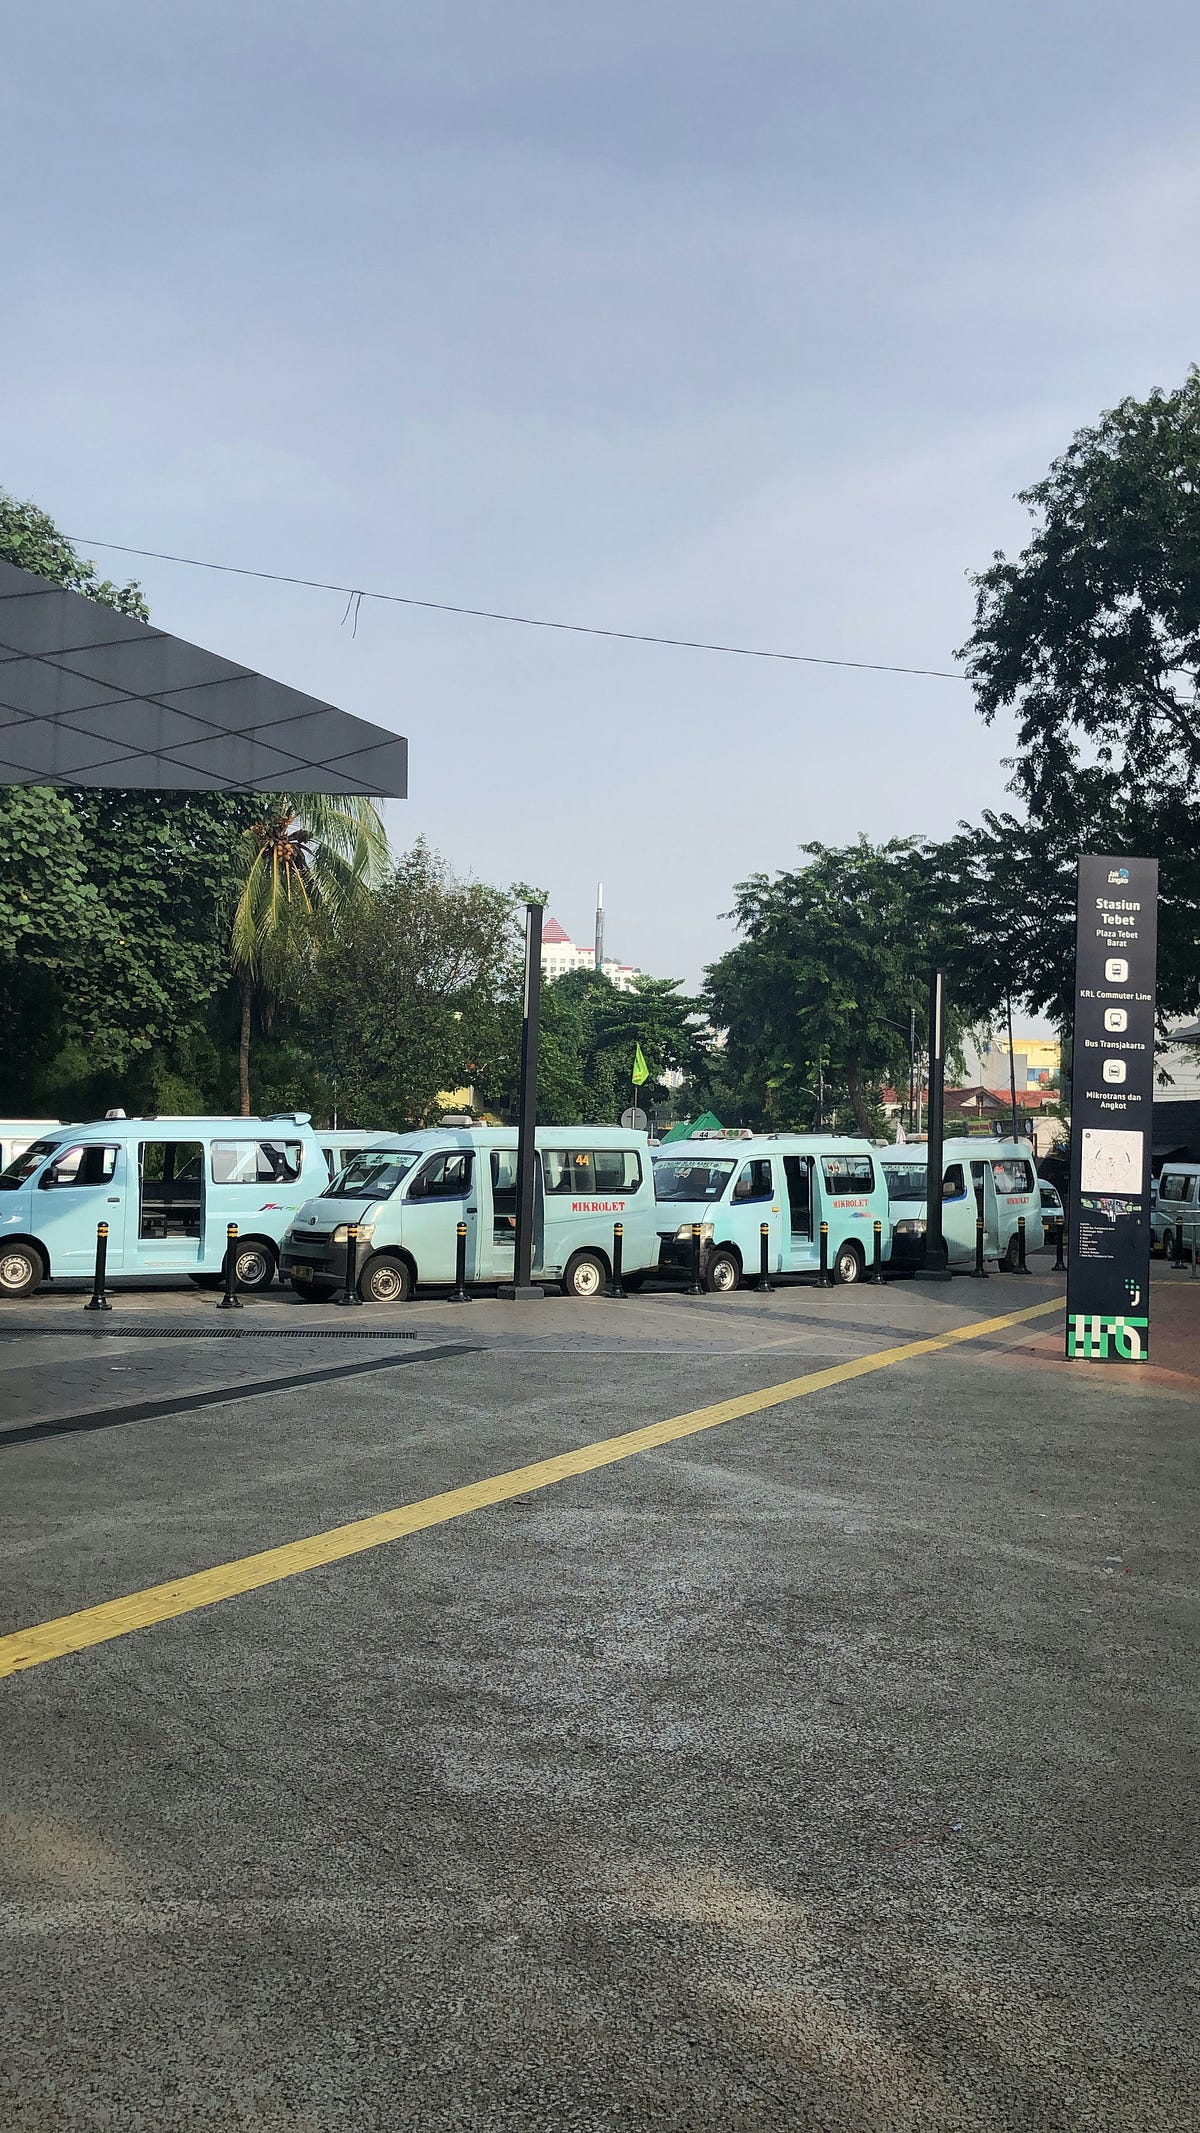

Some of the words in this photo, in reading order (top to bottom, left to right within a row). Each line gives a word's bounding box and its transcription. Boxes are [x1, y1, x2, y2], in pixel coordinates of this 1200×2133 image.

[1095, 898, 1141, 911] Stasiun
[1101, 913, 1135, 926] Tebet
[1096, 929, 1117, 938] Plaza
[1117, 930, 1138, 939] Tebet
[1107, 938, 1127, 947] Barat
[1080, 990, 1095, 998] KRL
[1096, 990, 1134, 1000] Commuter
[1135, 992, 1152, 1001] Line
[1085, 1039, 1099, 1048] Bus
[1100, 1040, 1145, 1050] Transjakarta
[1086, 1091, 1126, 1101] Mikrotrans
[1127, 1093, 1142, 1101] dan
[1100, 1101, 1127, 1110] Angkot
[575, 1154, 590, 1166] 44
[571, 1201, 625, 1212] MIKROLET
[832, 1199, 869, 1208] MIKROLET
